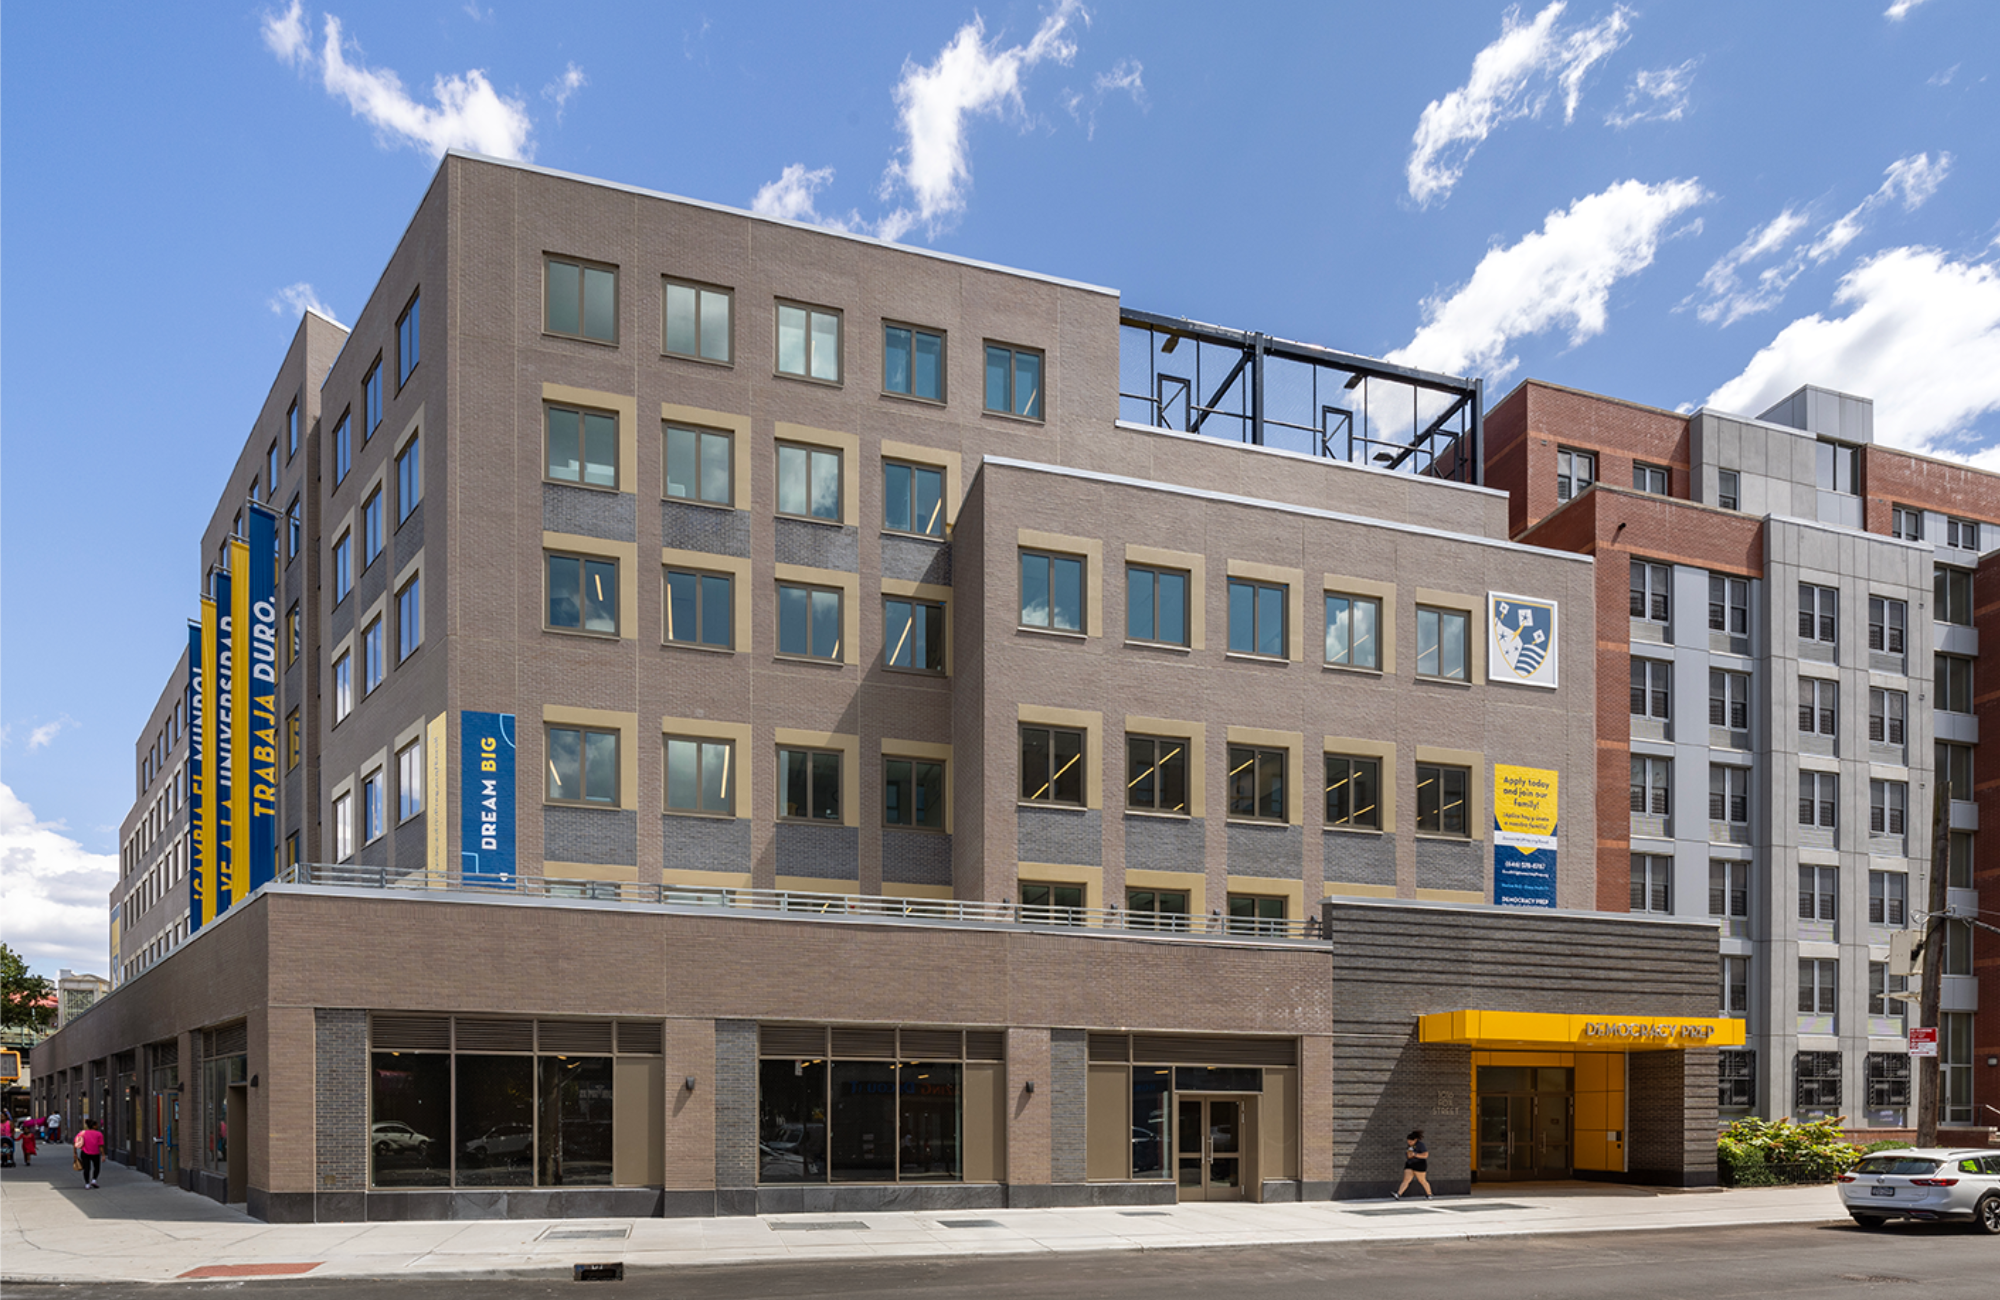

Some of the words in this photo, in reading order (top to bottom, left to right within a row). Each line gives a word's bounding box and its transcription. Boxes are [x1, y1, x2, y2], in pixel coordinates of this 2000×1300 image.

[253, 596, 275, 684] DURO.
[253, 694, 275, 817] TRABAJA
[481, 737, 497, 772] BIG
[1503, 776, 1526, 788] Apply
[1528, 779, 1550, 790] today
[1503, 788, 1518, 796] and
[1518, 788, 1534, 798] join
[1514, 798, 1540, 811] family!
[481, 780, 497, 850] DREAM
[1501, 896, 1535, 904] DEMOCRACY
[1586, 1022, 1677, 1038] DEMOCRACY
[1681, 1025, 1715, 1038] PREP
